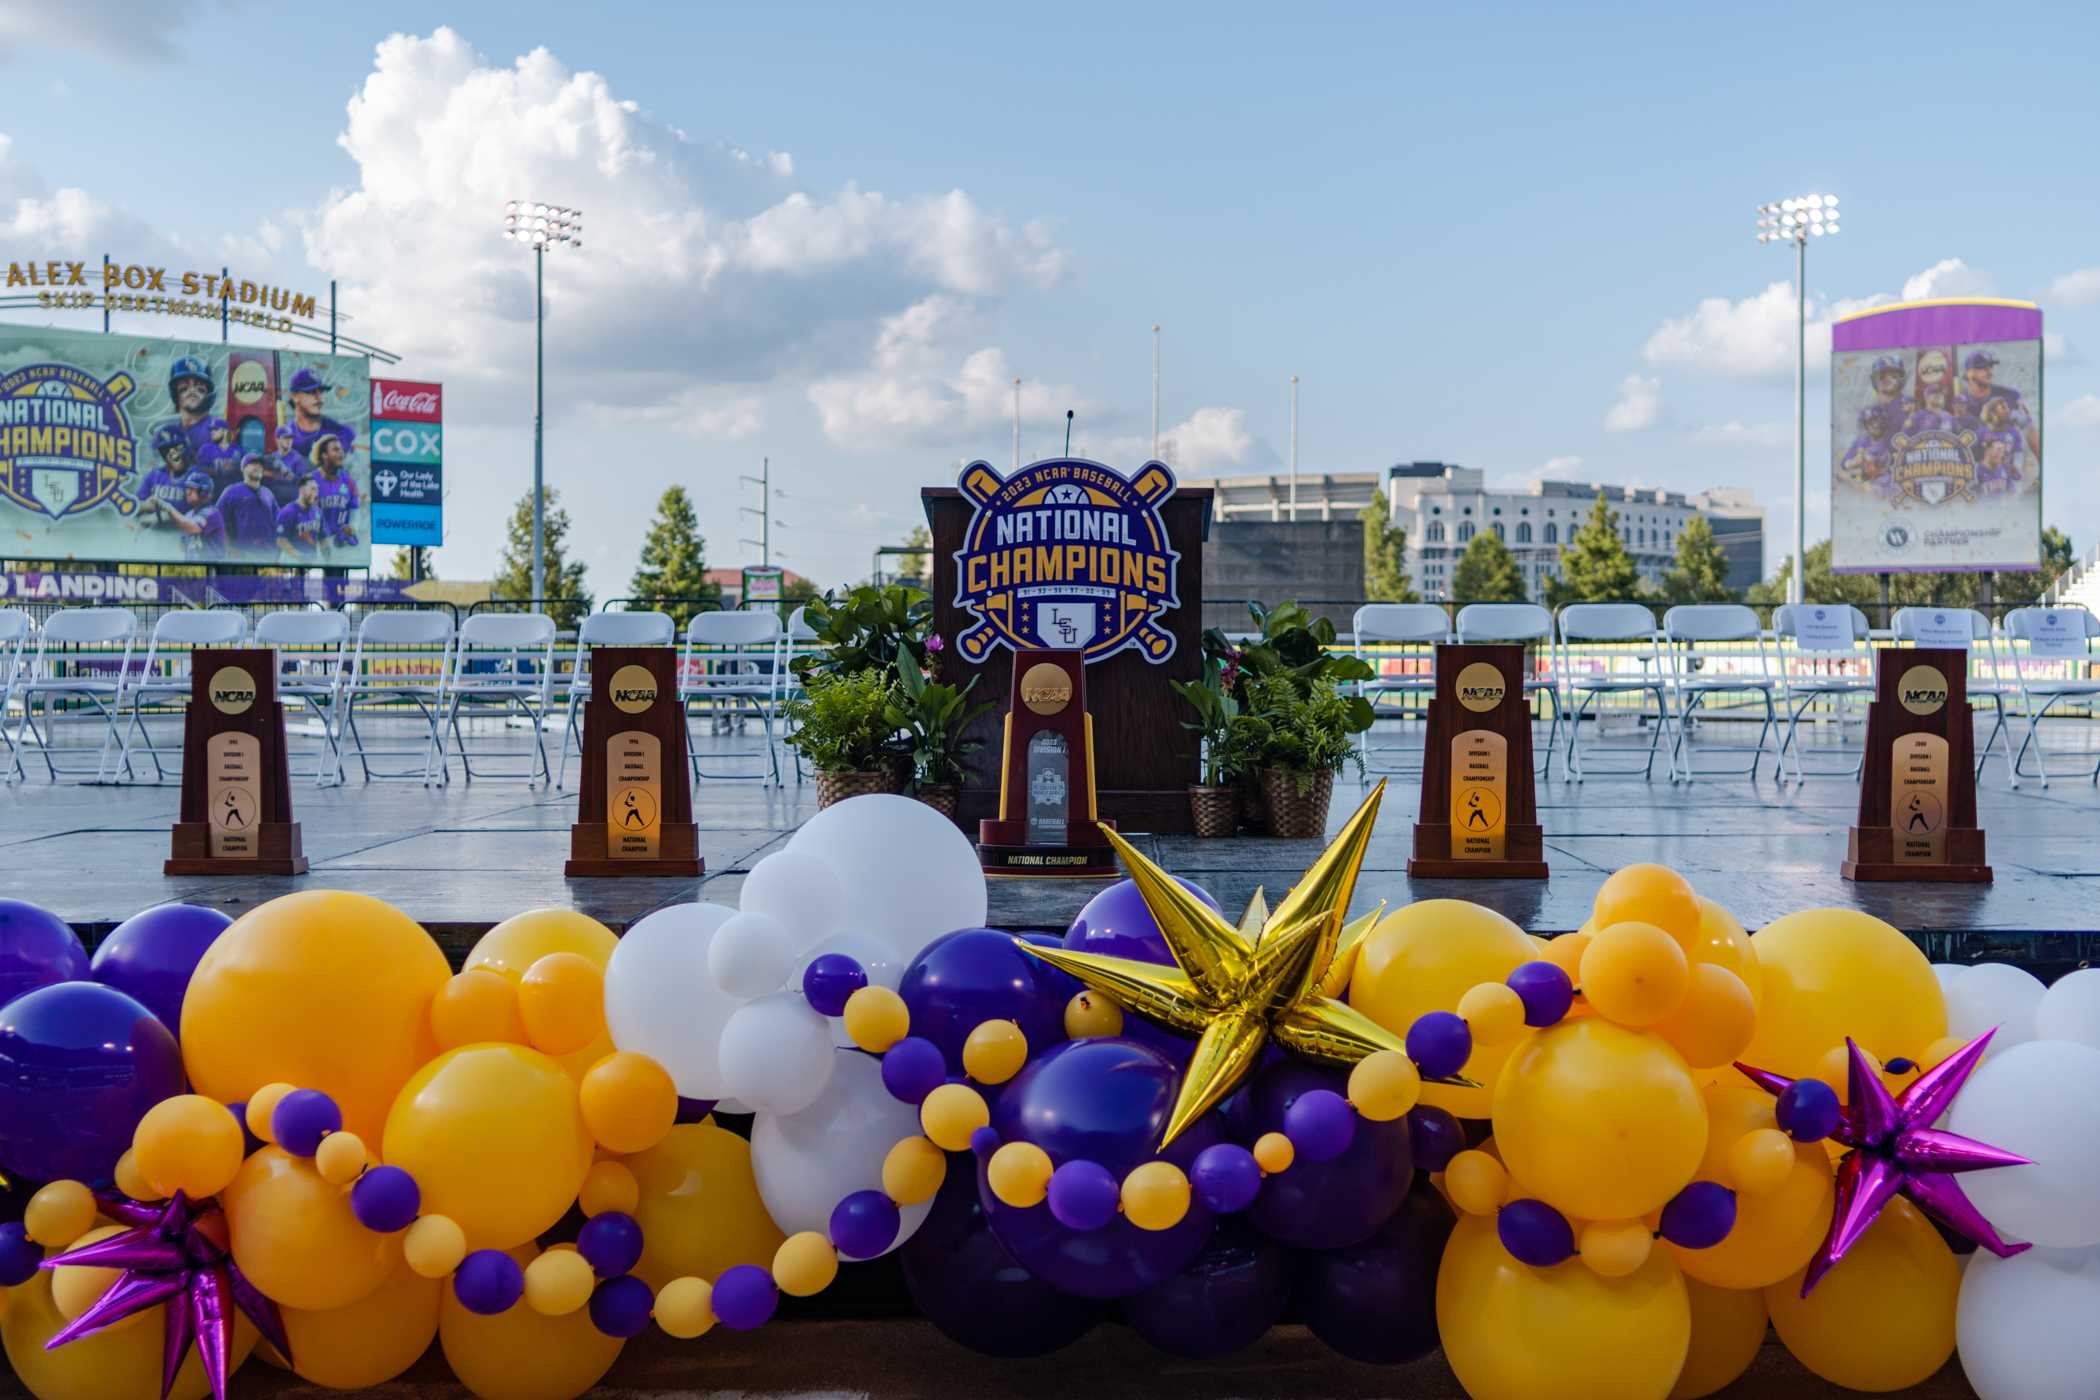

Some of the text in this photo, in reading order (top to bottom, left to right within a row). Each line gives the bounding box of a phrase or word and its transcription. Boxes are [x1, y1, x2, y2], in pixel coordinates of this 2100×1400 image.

[6, 261, 316, 319] ALEX BOX STADIUM
[37, 290, 96, 309] SKIP
[229, 308, 294, 333] FIELD
[235, 382, 265, 393] NCAA
[0, 398, 110, 433] NATIONAL
[0, 426, 132, 470] HAMPIONS
[373, 427, 441, 456] COX
[1001, 476, 1032, 502] 2023
[1073, 467, 1131, 502] BASEBALL
[996, 509, 1137, 546] NATIONAL
[967, 545, 1166, 593] CHAMPIONS
[16, 577, 158, 599] LANDING
[1051, 608, 1078, 643] LSU
[214, 690, 255, 703] NCAA
[614, 689, 656, 703] NCAA
[1904, 689, 1947, 703] NCAA
[1007, 855, 1088, 865] NATIONAL CHAMPION
